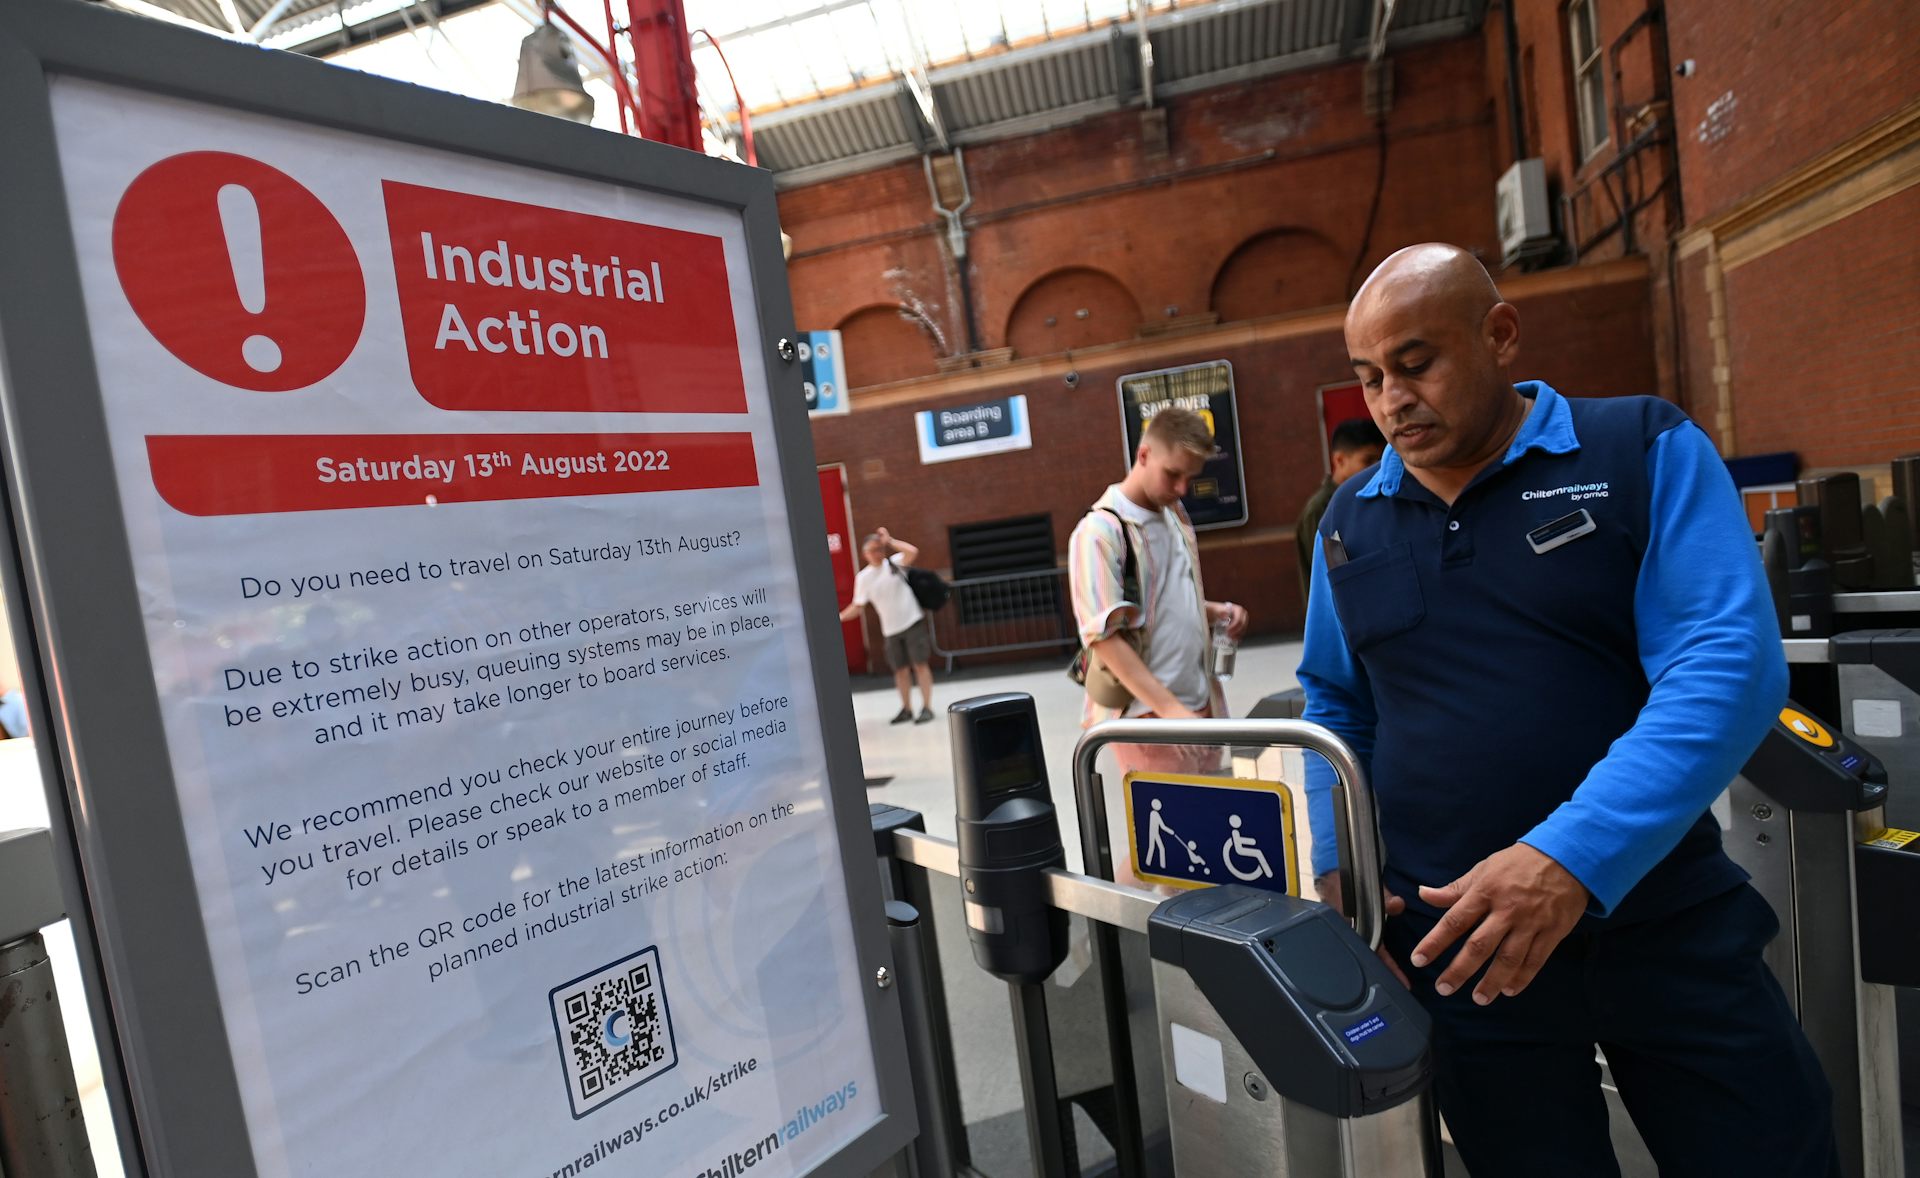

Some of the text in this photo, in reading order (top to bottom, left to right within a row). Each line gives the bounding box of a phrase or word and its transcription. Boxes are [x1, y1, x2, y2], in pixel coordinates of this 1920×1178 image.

[420, 231, 664, 303] Industrial
[434, 303, 609, 359] Action
[941, 405, 1002, 427] Boarding
[943, 426, 975, 442] area
[316, 454, 456, 483] Saturday
[521, 452, 607, 479] August
[613, 450, 670, 472] 2022
[1521, 482, 1609, 501] Chilternrailways
[1571, 491, 1609, 501] by arriva
[240, 530, 741, 599] Do you need to travel on Saturday 13th August?
[223, 587, 767, 692] Due to strike action on other operators, services will
[223, 615, 774, 728] be extremely busy, queuing systems may be in place,
[314, 647, 731, 745] and it may take longer to board services.
[243, 696, 788, 849] We recommend you check your entire journey before
[261, 719, 787, 886] you travel. Please check our website or social media
[346, 751, 751, 891] for details or speak to a member of staff.
[295, 803, 795, 995] Scan the QR code for the latest information on the
[428, 851, 728, 983] planned industrial strike action:
[545, 1057, 758, 1178] rnrailways.co.uk/strike
